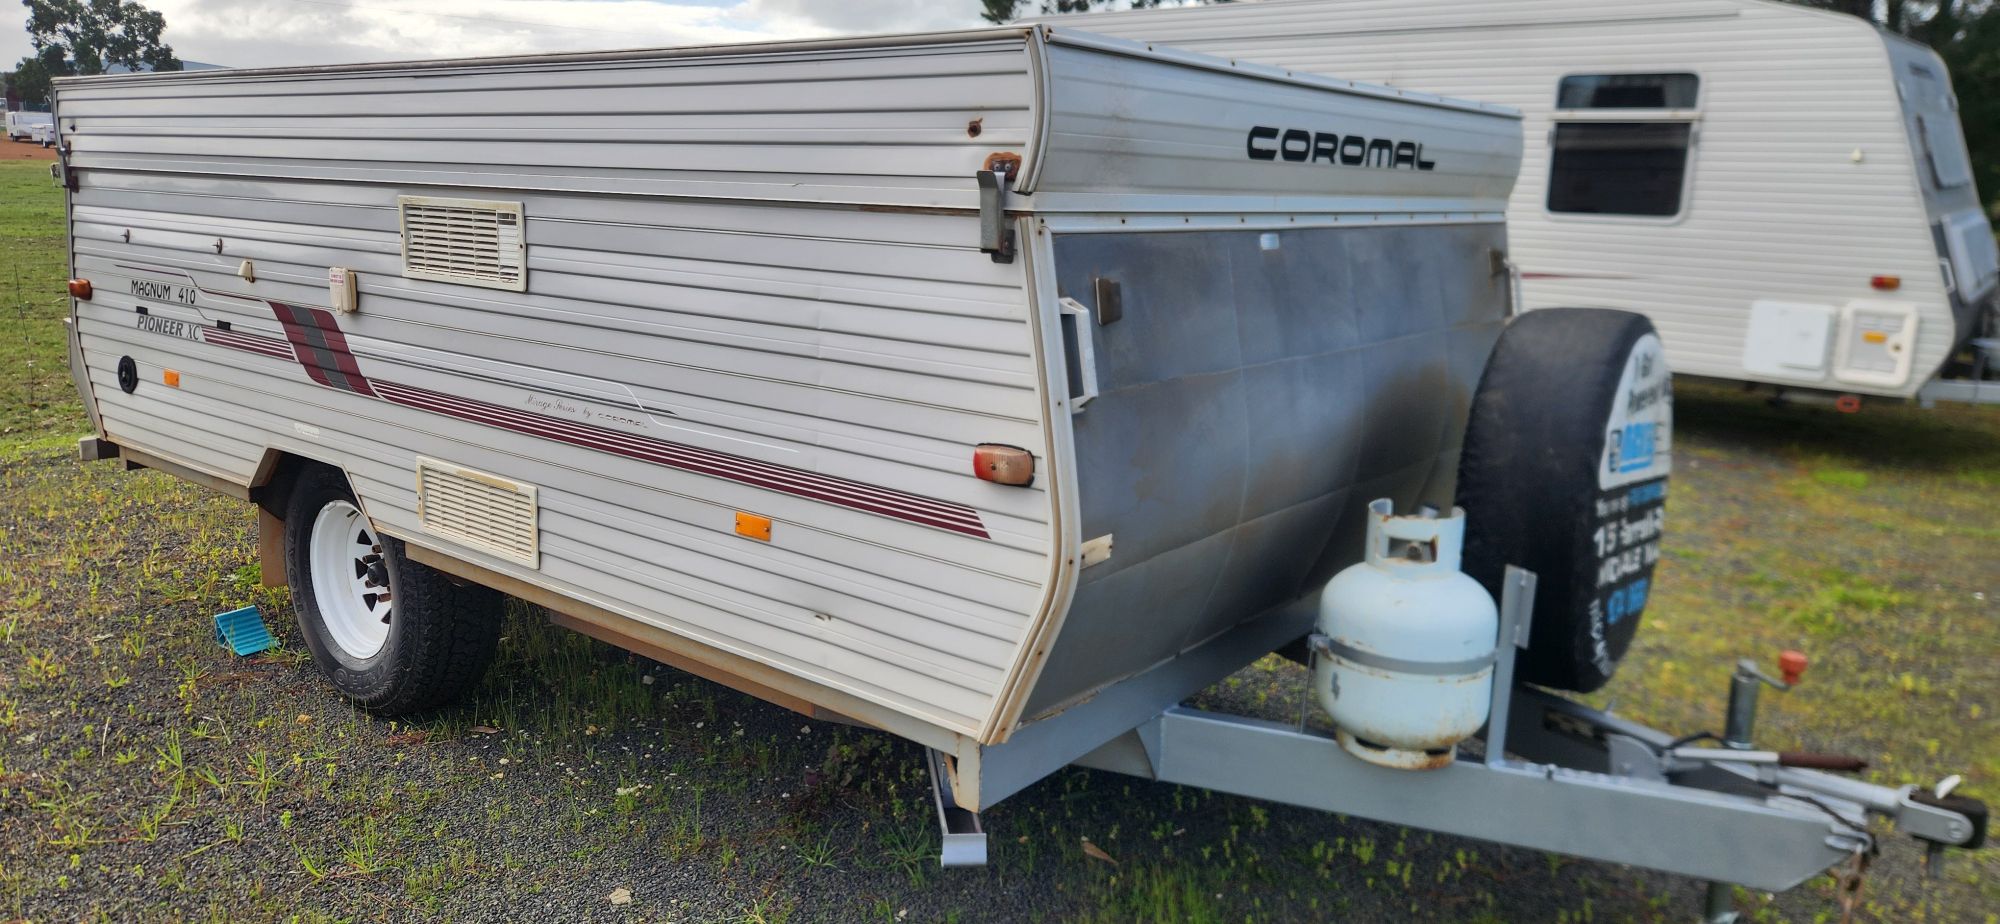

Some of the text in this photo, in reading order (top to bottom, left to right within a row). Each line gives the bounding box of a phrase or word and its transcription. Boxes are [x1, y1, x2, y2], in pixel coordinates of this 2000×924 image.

[1247, 125, 1436, 171] COROMAL
[131, 279, 196, 305] MAGNUM 410
[137, 315, 200, 341] PIONEER XC
